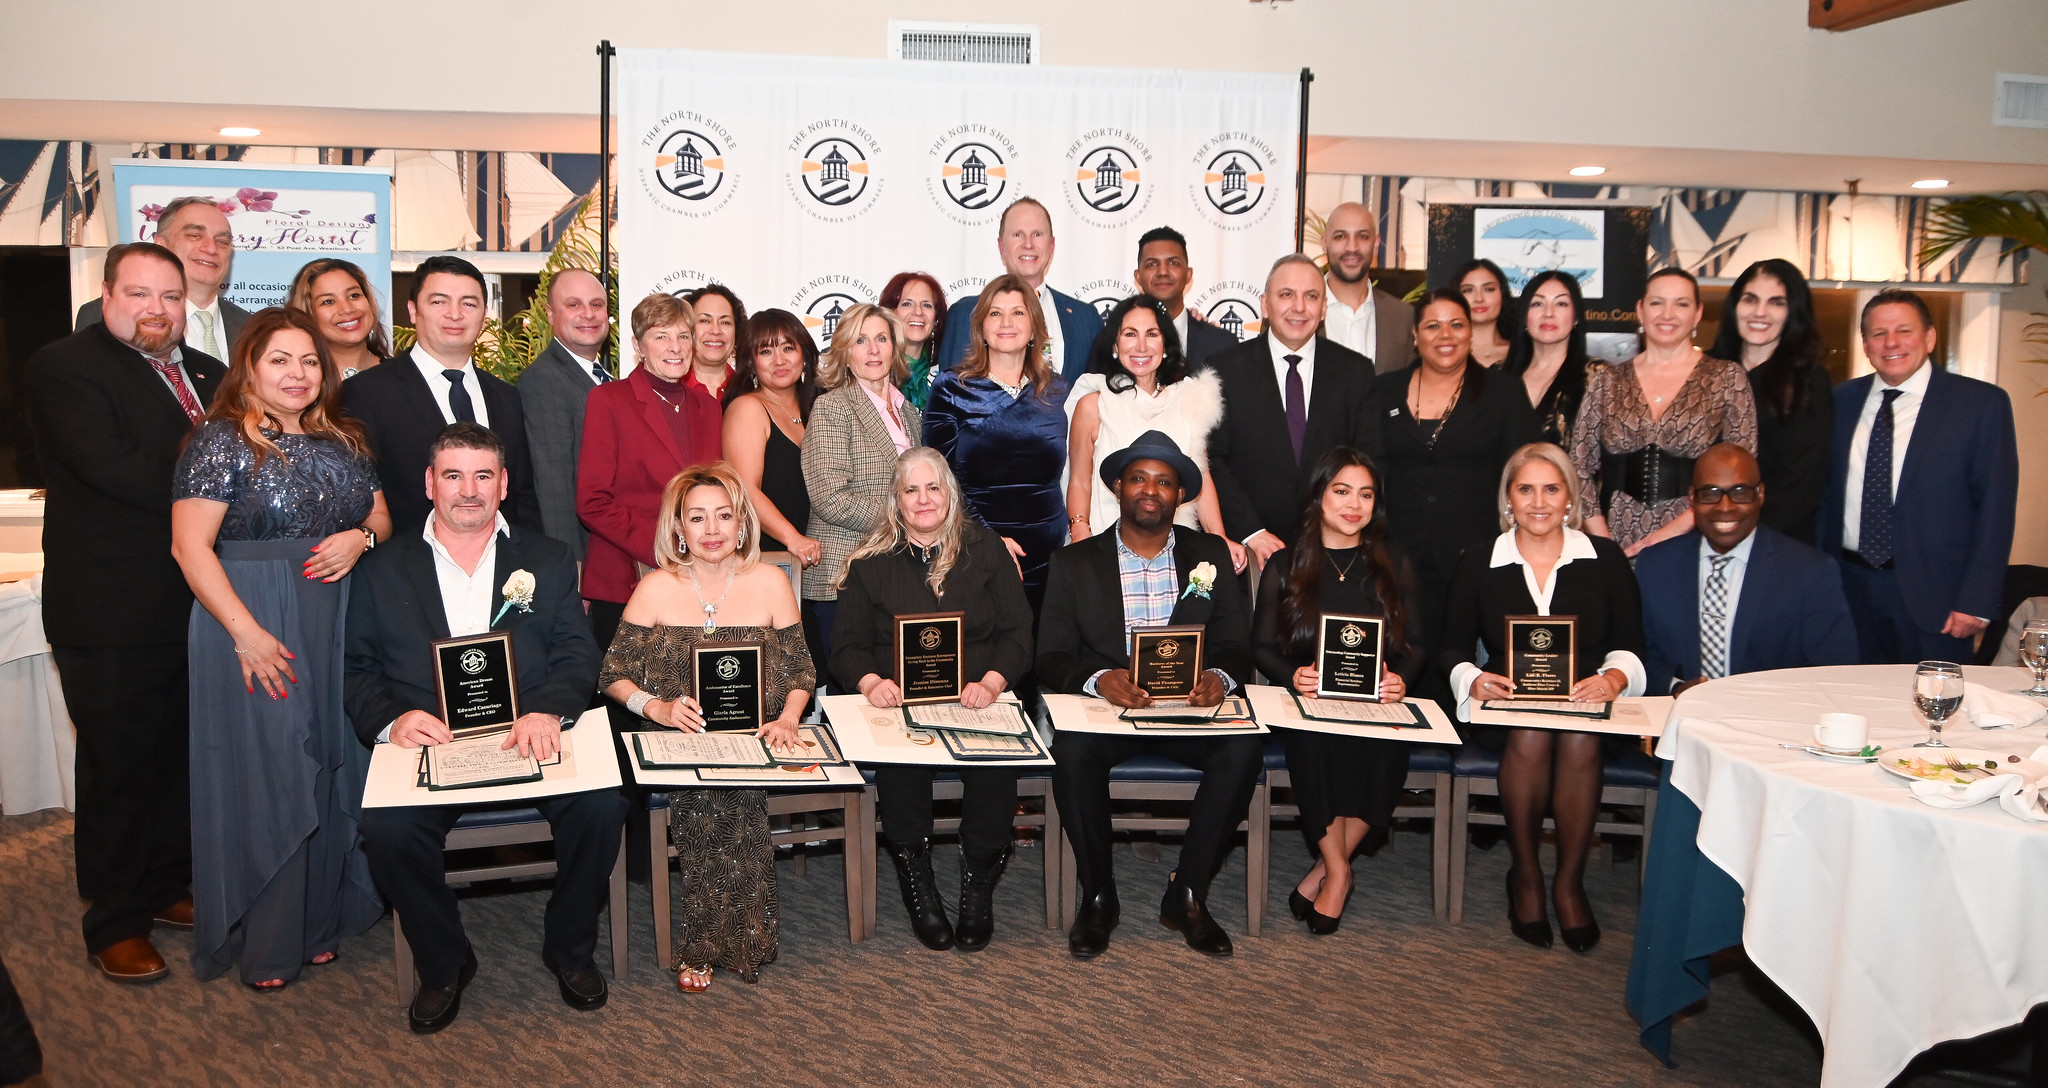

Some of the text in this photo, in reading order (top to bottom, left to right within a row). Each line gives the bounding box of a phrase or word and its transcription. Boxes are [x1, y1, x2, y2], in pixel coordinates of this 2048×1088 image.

[642, 110, 736, 150] THE NORTH SHORE
[789, 119, 881, 154] THE NORTH SHORE
[929, 124, 1018, 158] THE NORTH SHORE
[1066, 128, 1152, 161] THE NORTH SHORE
[1193, 131, 1277, 165] THE NORTH SHORE
[639, 168, 659, 204] HISPANIC
[661, 205, 698, 218] CHAMBER
[785, 173, 805, 208] HISPANIC
[807, 209, 843, 222] CHAMBER
[926, 178, 945, 212] HISPANIC
[947, 213, 981, 226] CHAMBER
[1062, 180, 1079, 215] HISPANIC
[1081, 216, 1116, 228] CHAMBER
[1189, 184, 1207, 218] HISPANIC
[1209, 219, 1241, 231] CHAMBER
[270, 227, 369, 246] Florist
[233, 282, 246, 290] all
[248, 282, 292, 291] occasion
[649, 283, 664, 297] HE
[664, 270, 705, 284] NORTH
[791, 274, 879, 308] THE NORTH SHOR
[949, 277, 987, 292] NORTH
[1082, 279, 1120, 293] NORTH
[1195, 292, 1208, 308] HE
[1209, 281, 1245, 294] NORTH
[222, 295, 286, 307] nd-arranged
[457, 705, 477, 713] Edward
